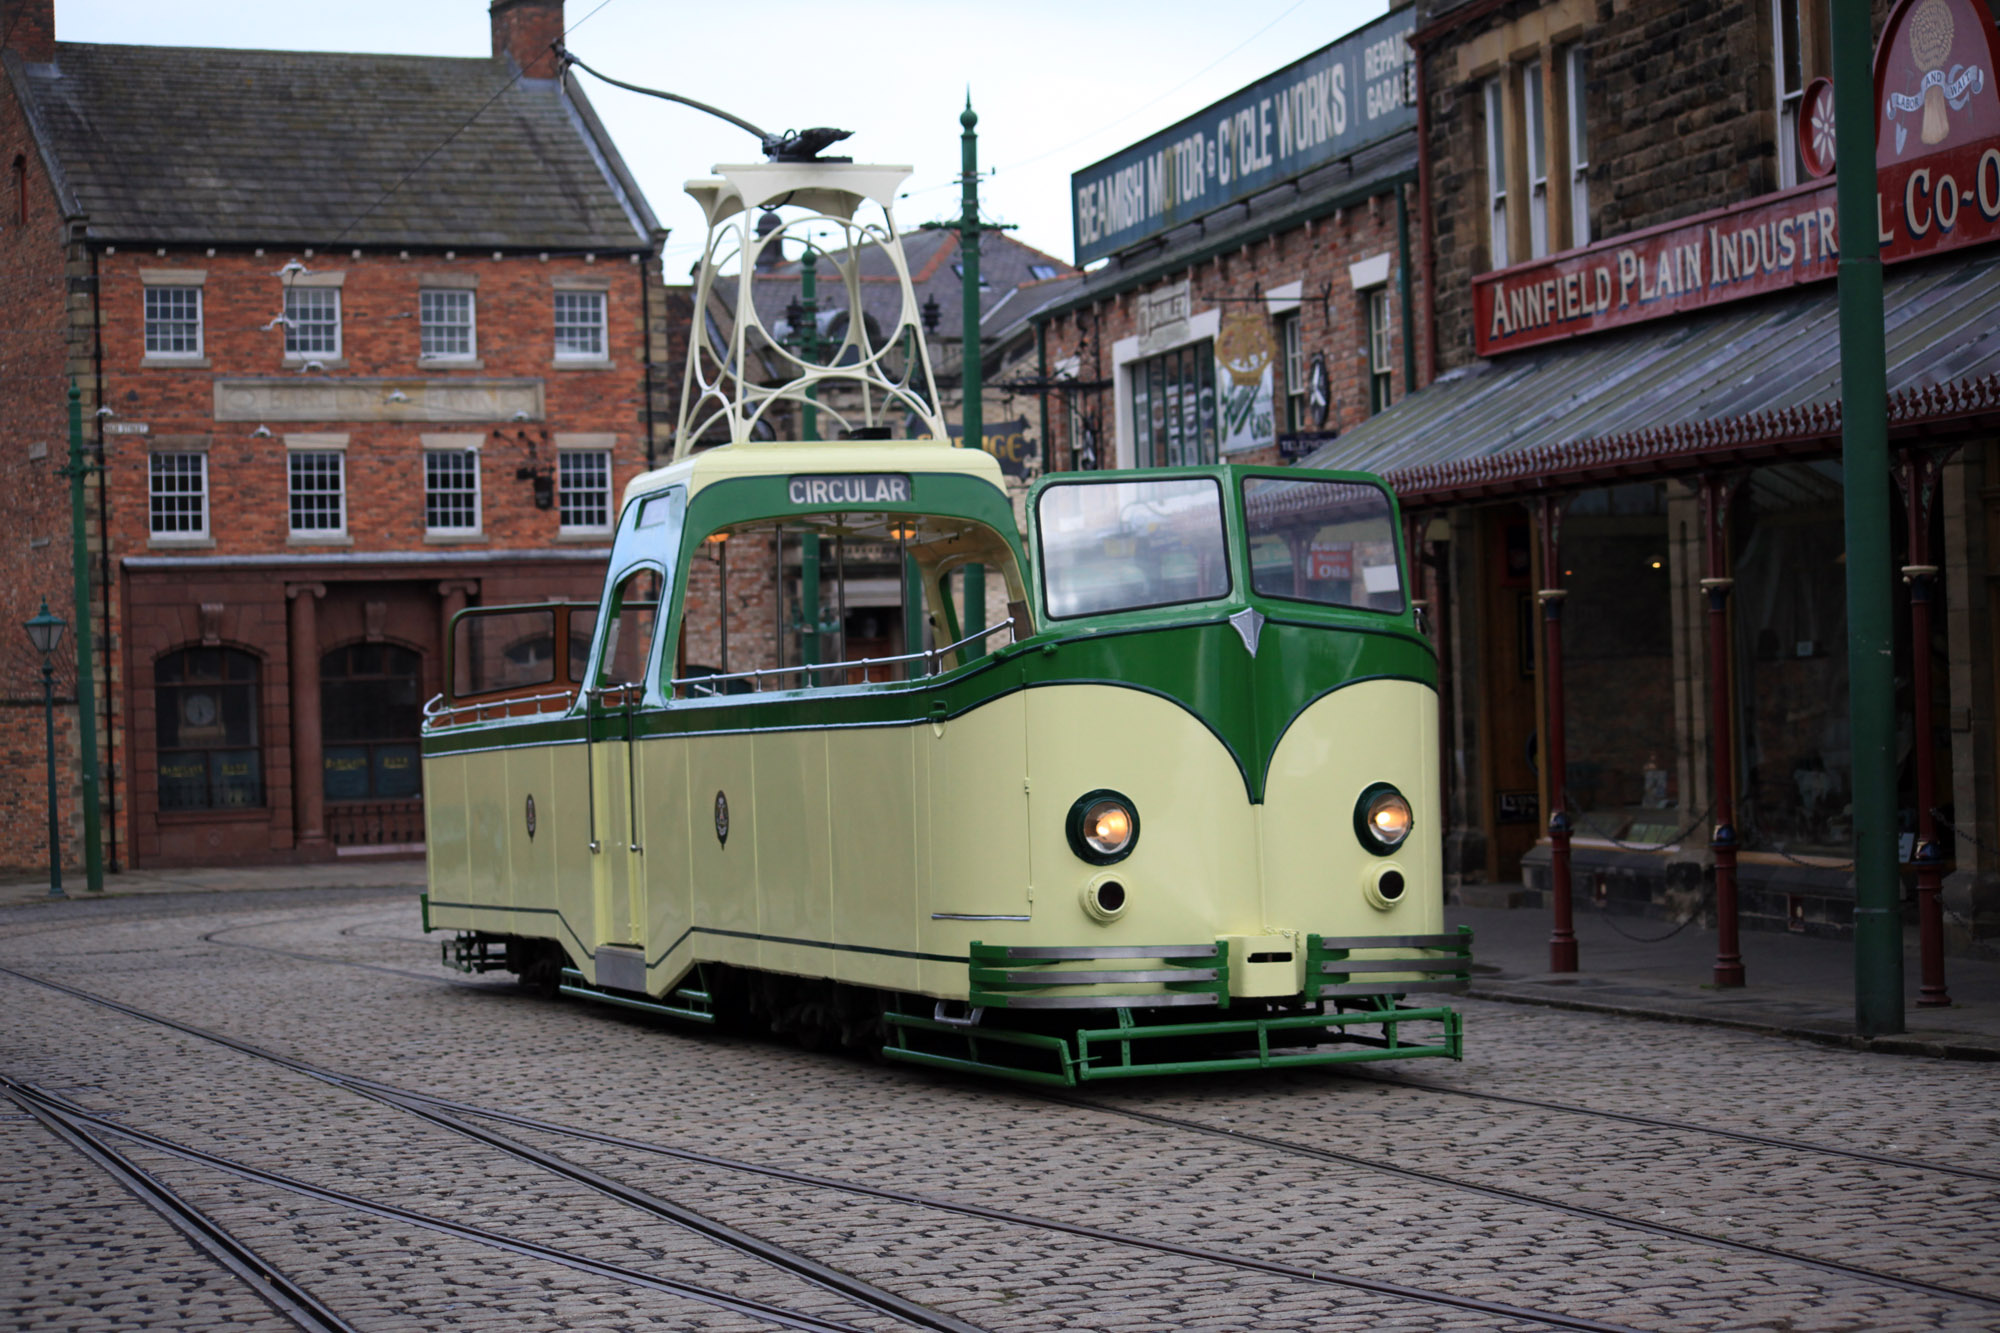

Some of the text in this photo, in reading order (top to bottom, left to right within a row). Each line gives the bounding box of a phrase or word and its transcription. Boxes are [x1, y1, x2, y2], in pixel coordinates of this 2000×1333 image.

[1894, 70, 1971, 110] LABOR AND WAIT
[1078, 160, 1145, 247] BEAMISH
[1148, 132, 1206, 218] MOTOR
[1217, 98, 1273, 186] CYCLE
[1275, 62, 1346, 160] WORKS
[1489, 266, 1612, 340] ANNFIELD
[1617, 242, 1702, 305] PLAIN
[1708, 193, 1894, 287] INDUSTRL
[788, 478, 908, 505] CIRCULAR
